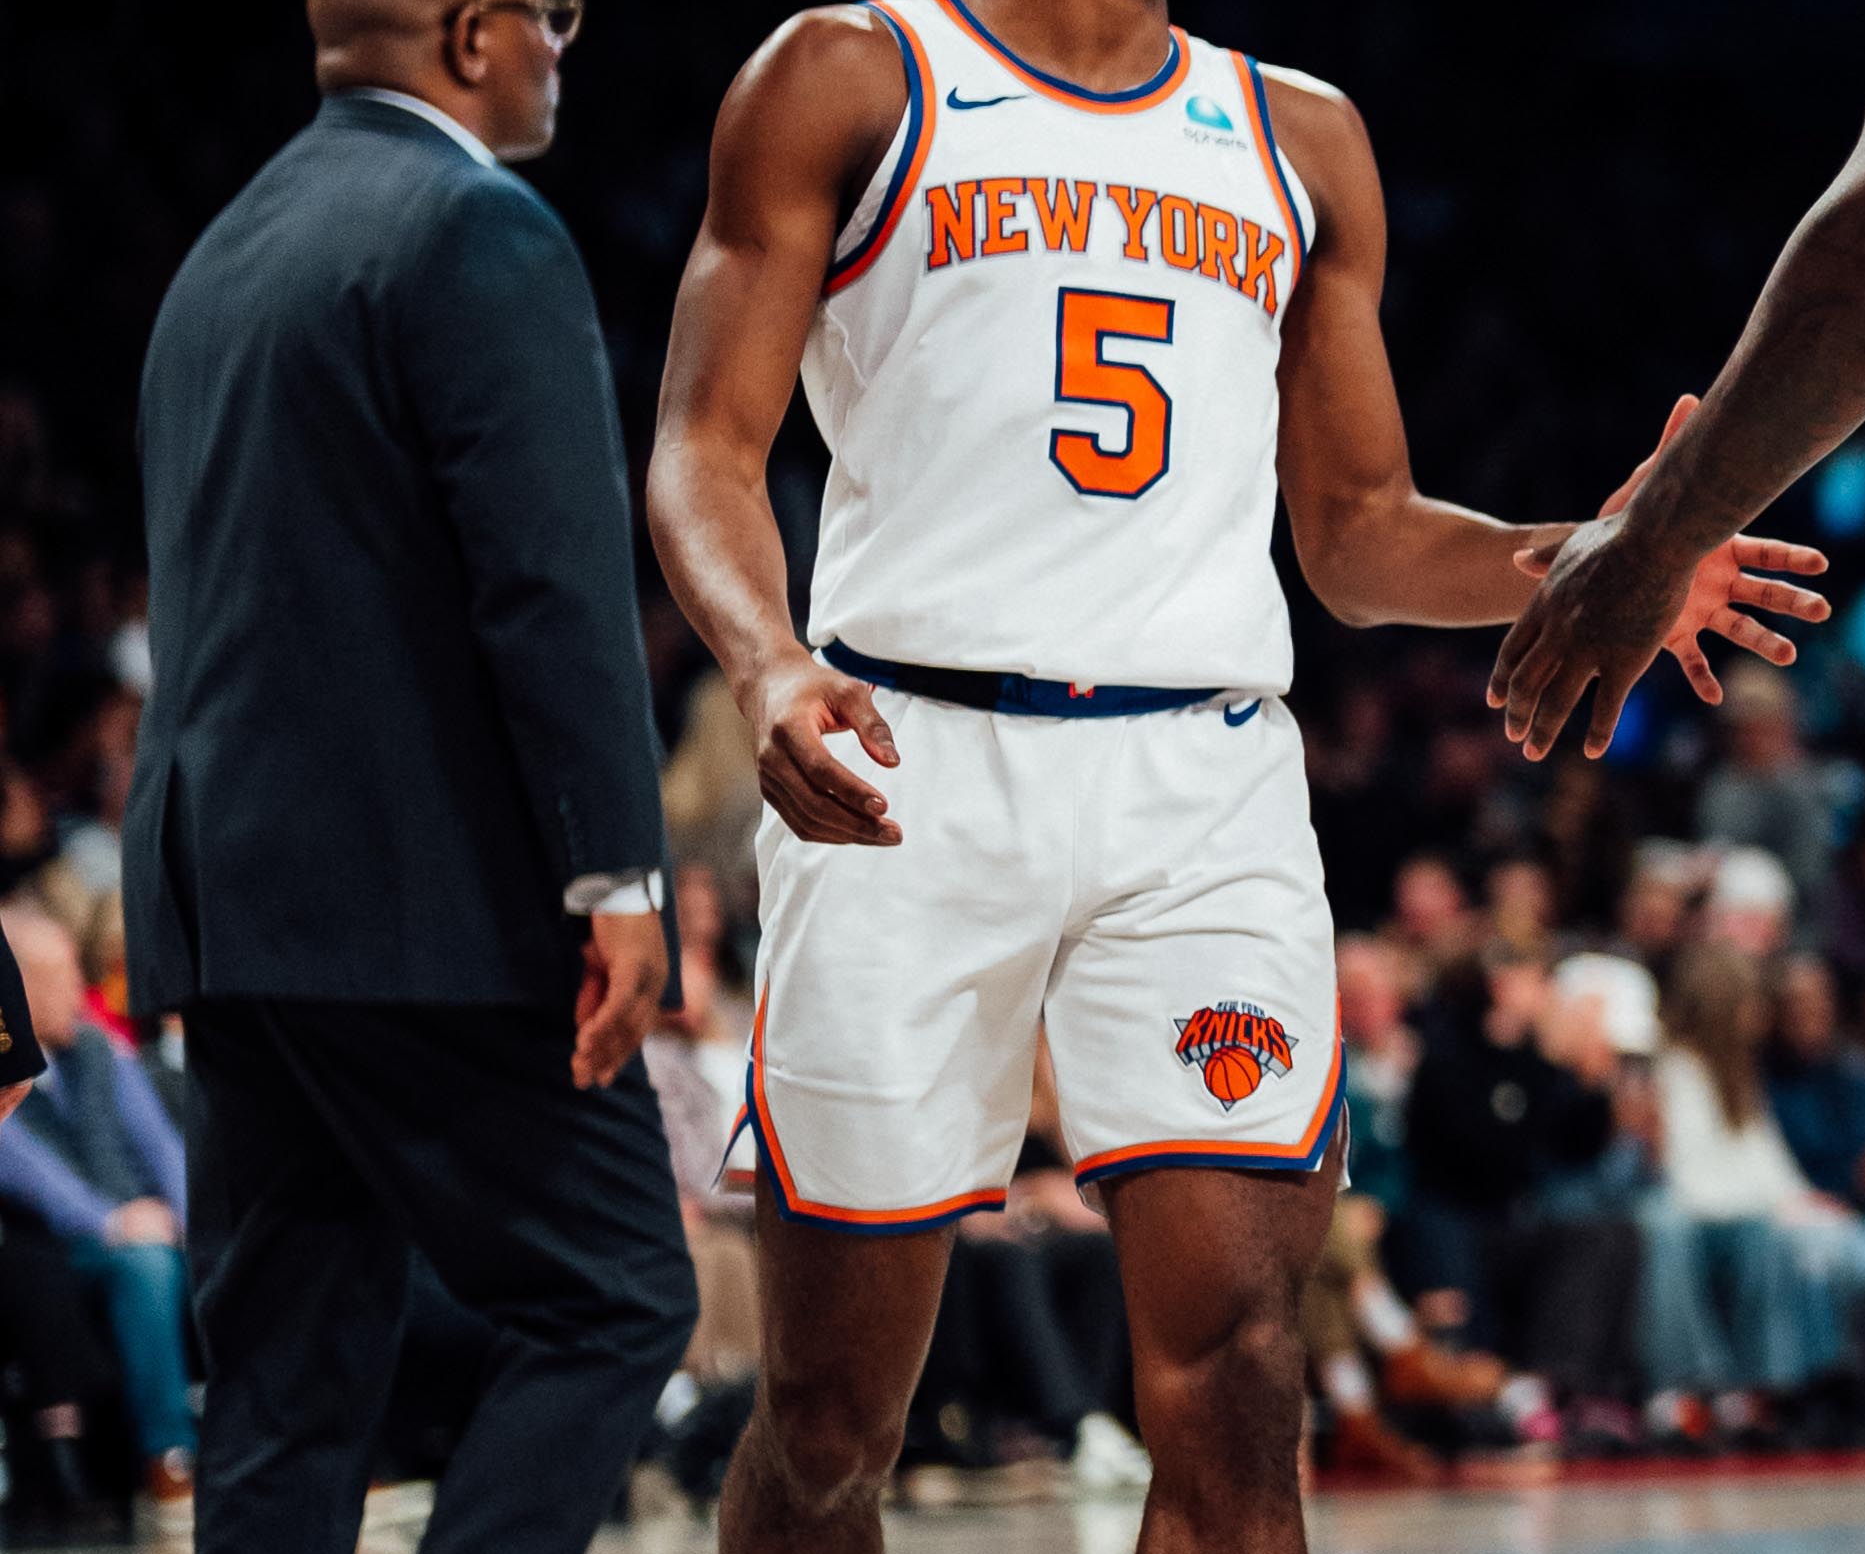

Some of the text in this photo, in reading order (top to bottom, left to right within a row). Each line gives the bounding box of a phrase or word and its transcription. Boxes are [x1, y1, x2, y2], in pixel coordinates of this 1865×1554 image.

[925, 176, 1286, 319] NEW YORK
[1049, 287, 1176, 500] 5
[1176, 1006, 1293, 1076] KNICKS
